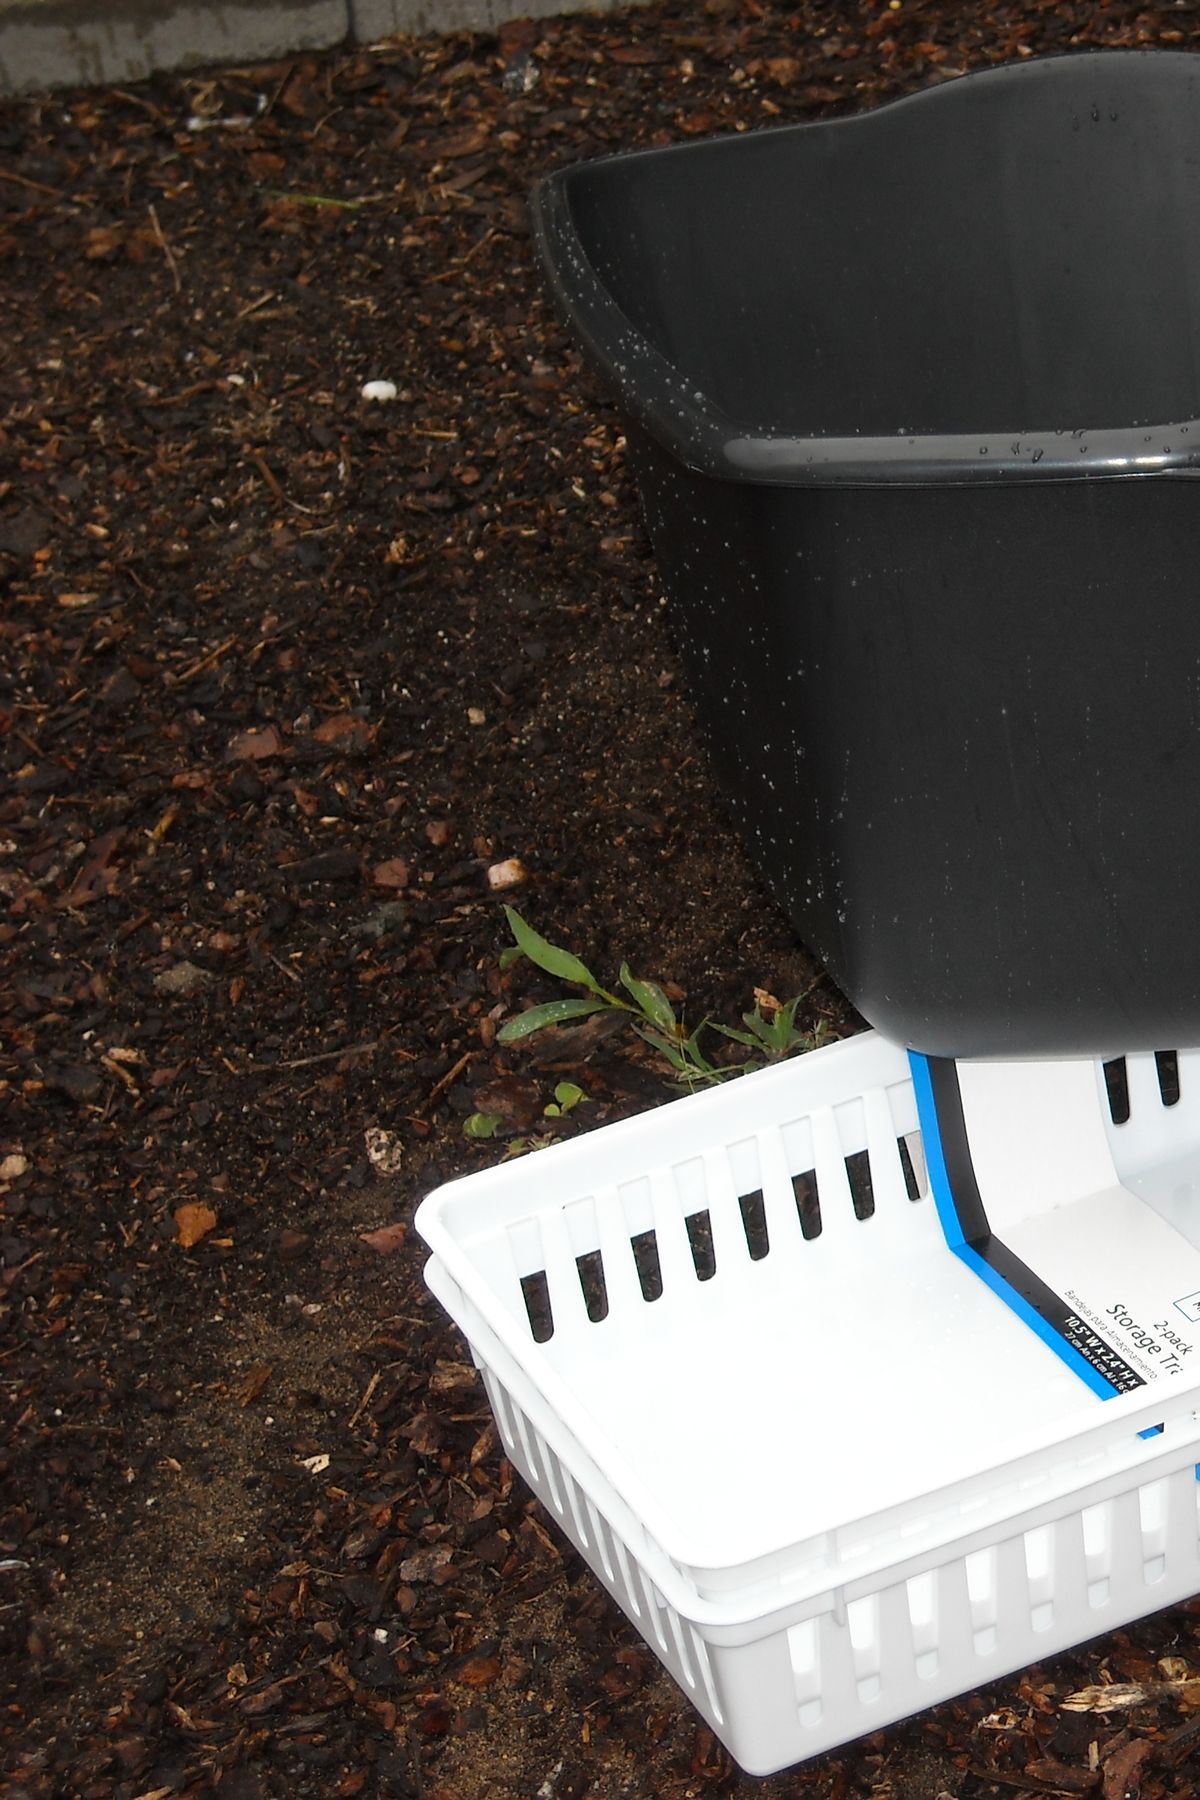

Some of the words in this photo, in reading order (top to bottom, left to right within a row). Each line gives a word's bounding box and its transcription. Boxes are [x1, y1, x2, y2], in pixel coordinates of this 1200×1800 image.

[1064, 1289, 1092, 1317] Bandejas
[1091, 1315, 1108, 1331] para
[1106, 1303, 1162, 1355] Storage
[1064, 1315, 1092, 1336] 10.5"
[1085, 1335, 1102, 1348] W
[1094, 1347, 1107, 1355] x
[1101, 1352, 1126, 1369] 2.4"
[1118, 1369, 1134, 1380] H
[1127, 1378, 1139, 1387] x
[1153, 1320, 1195, 1356] 2-pack
